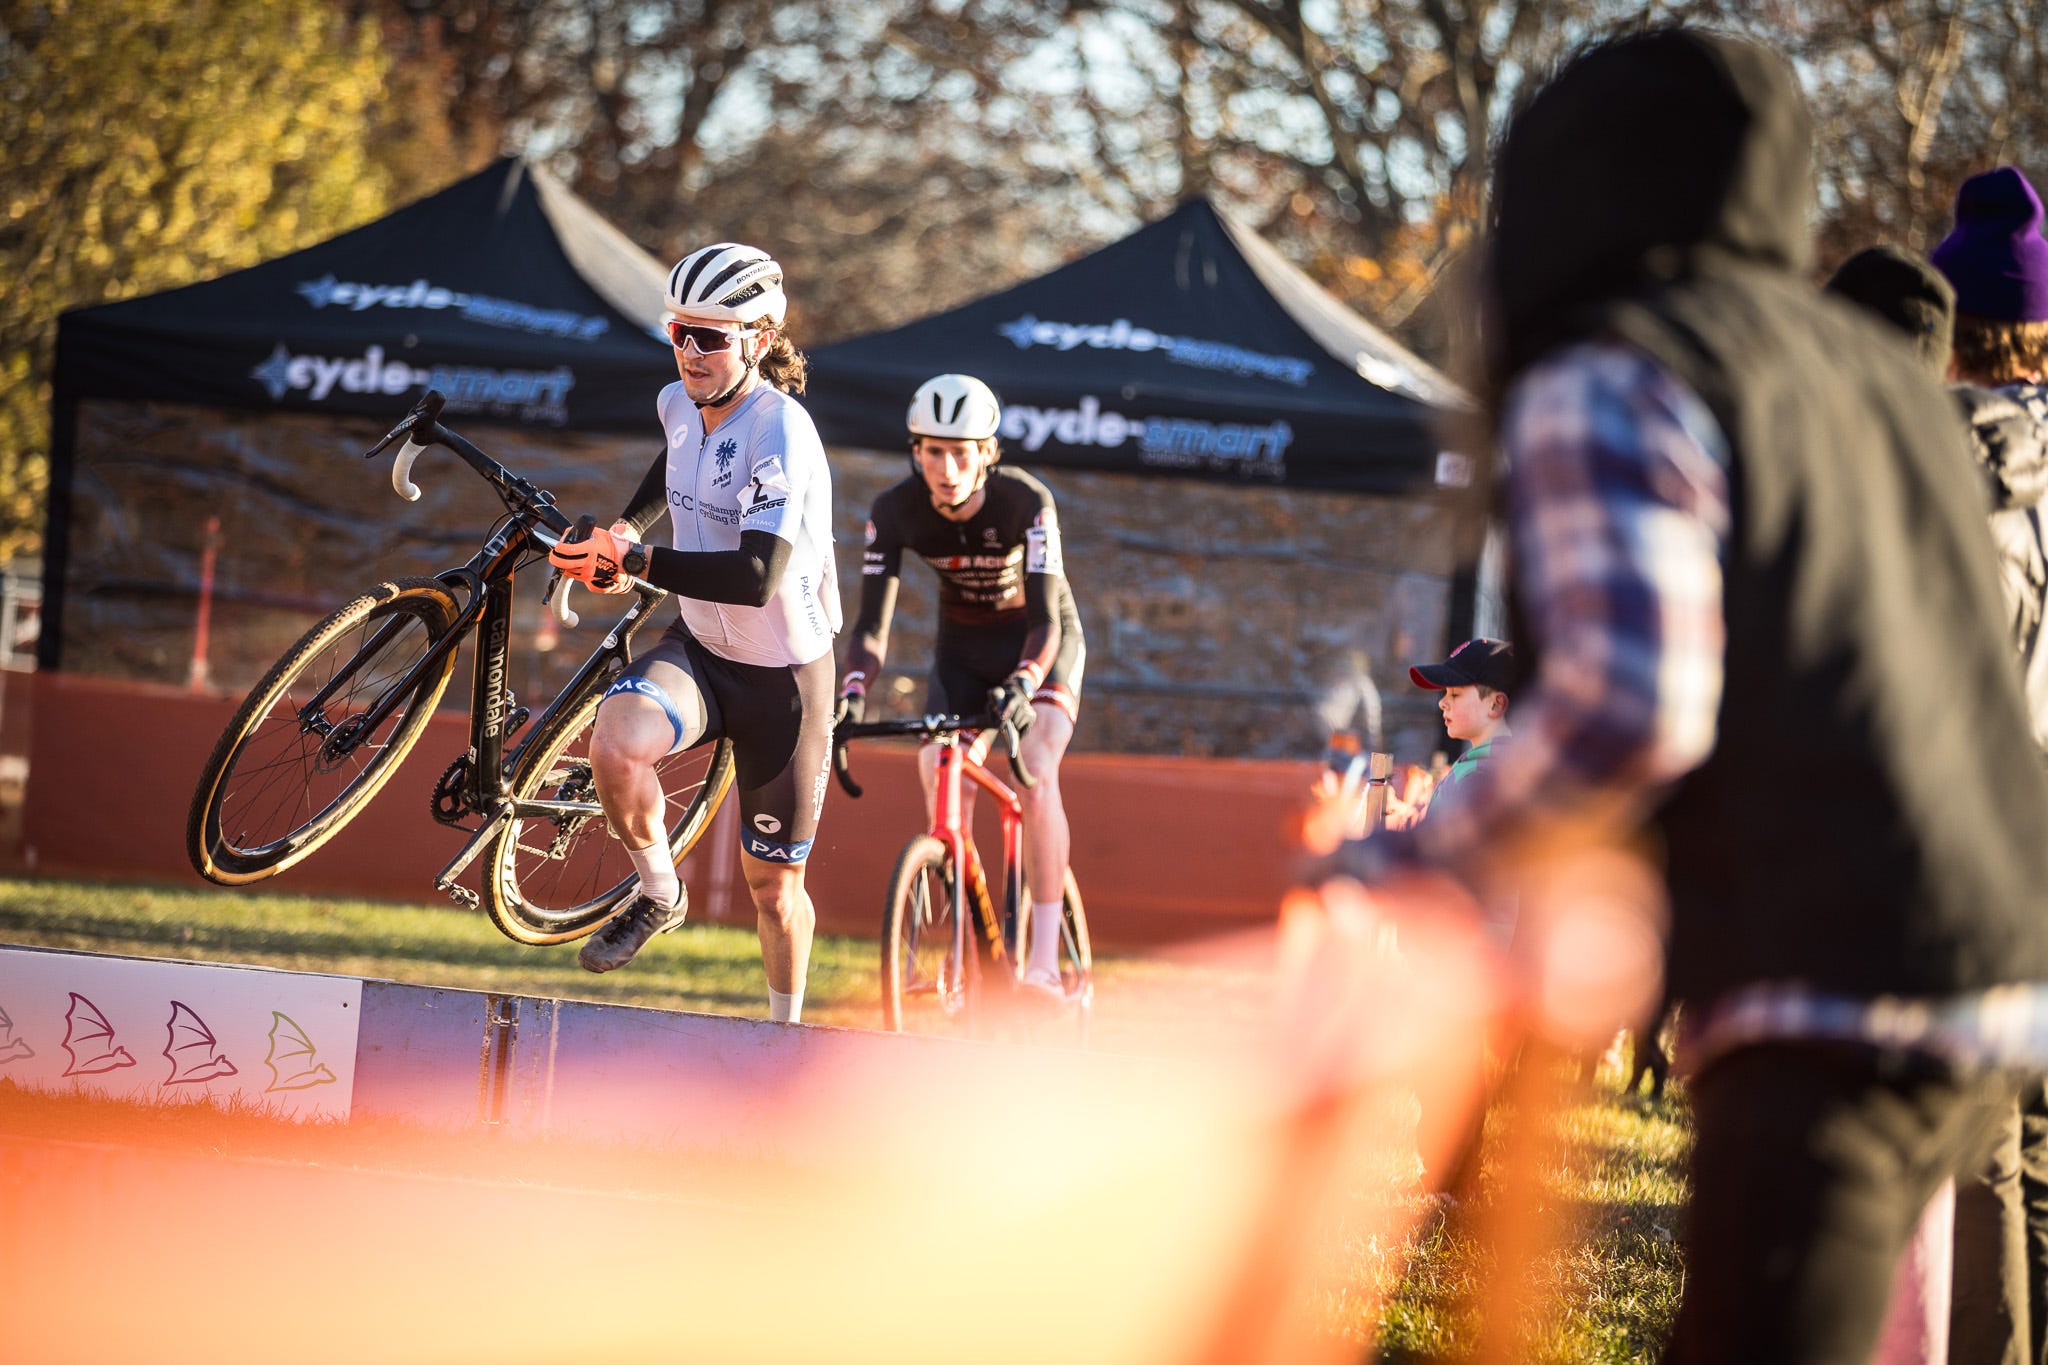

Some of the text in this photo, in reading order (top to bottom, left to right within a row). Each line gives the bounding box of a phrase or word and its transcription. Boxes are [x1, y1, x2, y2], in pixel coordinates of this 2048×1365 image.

[286, 345, 576, 404] cycle-smart
[1001, 396, 1294, 460] cycle-smart
[711, 470, 732, 487] JAM
[748, 476, 769, 505] 2
[700, 508, 729, 526] cycling
[742, 497, 787, 518] VERGE
[800, 575, 823, 636] PACTIMO
[484, 618, 507, 738] cannondale
[751, 839, 808, 860] PAC
